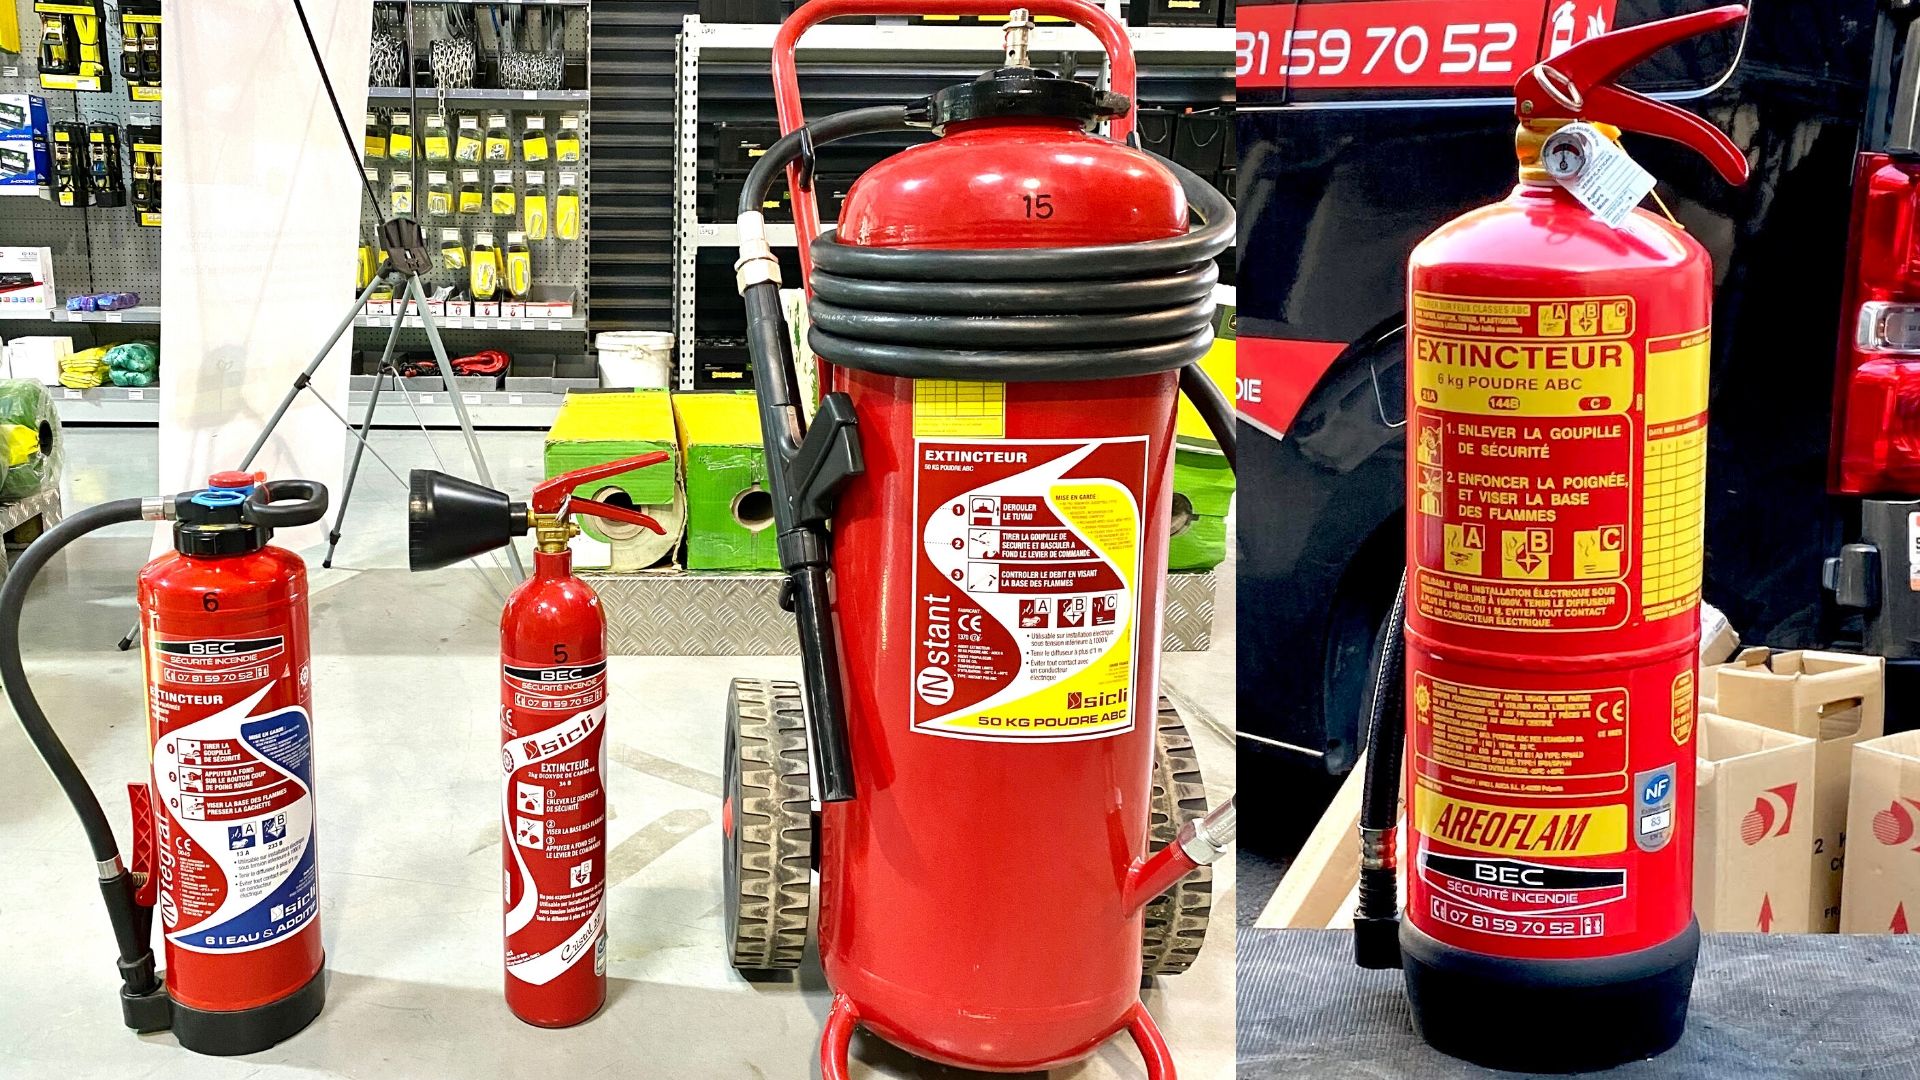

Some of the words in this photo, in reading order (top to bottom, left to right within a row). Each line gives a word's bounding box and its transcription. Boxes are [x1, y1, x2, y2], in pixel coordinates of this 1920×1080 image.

[1280, 29, 1351, 76] 59
[1361, 25, 1428, 74] 70
[1439, 22, 1518, 73] 52
[1022, 194, 1054, 221] 15
[1554, 304, 1566, 319] A
[1585, 303, 1598, 317] B
[1616, 302, 1626, 316] C
[1417, 338, 1623, 369] EXTINCTEUR
[1437, 373, 1444, 384] 6
[1447, 374, 1464, 389] kg
[1468, 376, 1538, 390] POUDRE
[1544, 378, 1583, 390] ABC
[1590, 399, 1600, 408] C
[1458, 424, 1516, 439] ENLEVER
[1523, 428, 1543, 439] LA
[1550, 425, 1622, 440] GOUPILLE
[925, 449, 1028, 463] EXTINCTEUR
[1458, 442, 1475, 454] DE
[1480, 441, 1550, 458] SÉCURITÉ
[1458, 472, 1530, 489] ENFONCER
[1537, 477, 1555, 489] LA
[1562, 472, 1629, 489] POIGNÉE,
[1458, 489, 1473, 501] ET
[1478, 490, 1518, 505] VISER
[1525, 493, 1543, 506] LA
[1551, 493, 1590, 506] BASE
[1002, 512, 1011, 520] LE
[1012, 512, 1033, 520] TUYAU
[1458, 505, 1482, 518] DES
[1489, 507, 1556, 521] FLAMMES
[1002, 533, 1019, 541] TIRER
[1020, 533, 1028, 541] LA
[1029, 533, 1058, 542] GOUPILLE
[1032, 541, 1040, 549] ET
[1040, 541, 1069, 550] BASCULER
[1465, 527, 1483, 548] A
[1531, 531, 1548, 551] B
[1602, 528, 1620, 550] C
[1001, 550, 1019, 559] FOND
[1020, 550, 1028, 558] LE
[1028, 550, 1049, 558] LEVIER
[1050, 550, 1058, 558] DE
[1058, 549, 1091, 558] COMMANDE
[1077, 568, 1098, 577] VISANT
[1001, 579, 1010, 587] LA
[1010, 579, 1029, 587] BASE
[1029, 579, 1042, 587] DES
[1043, 579, 1074, 587] FLAMMES
[1471, 584, 1530, 597] INSTALLATION
[1533, 585, 1590, 597] ÉLECTRIQUE
[1592, 586, 1616, 596] SOUS
[203, 592, 219, 613] 6
[1037, 601, 1048, 612] A
[1074, 599, 1084, 610] B
[1106, 596, 1116, 609] C
[1538, 608, 1562, 617] TOUT
[1564, 607, 1606, 617] CONTACT
[189, 642, 236, 655] BEC
[553, 643, 568, 664] 5
[170, 654, 213, 666] SÉCURITÉ
[214, 653, 259, 665] INCENDIE
[178, 674, 190, 682] 07
[192, 675, 204, 683] 81
[204, 675, 220, 684] 59
[222, 673, 237, 682] 70
[238, 671, 254, 680] 52
[540, 668, 583, 681] BEC
[521, 682, 563, 691] SÉCURITÉ
[563, 678, 597, 691] INCENDIE
[528, 699, 539, 707] 07
[553, 700, 568, 708] 59
[569, 698, 581, 707] 70
[1084, 688, 1127, 709] sicli
[979, 716, 1001, 726] 50
[1006, 717, 1029, 727] KG
[1034, 715, 1098, 727] POUDRE
[1101, 709, 1127, 722] ABC
[541, 714, 596, 755] sicli
[541, 758, 589, 773] EXTINCTEUR
[233, 798, 250, 806] BASE
[250, 795, 262, 804] DES
[262, 787, 288, 802] FLAMMES
[1645, 778, 1669, 801] NF
[276, 813, 286, 826] B
[1432, 802, 1592, 851] AREOFLAM
[245, 823, 255, 835] A
[1814, 838, 1824, 855] 2
[1475, 863, 1544, 886] BEC
[285, 883, 316, 917] sicli
[1447, 880, 1509, 901] SÉCURITÉ
[1511, 891, 1579, 905] INCENDIE
[1450, 909, 1468, 922] 07
[1472, 916, 1489, 928] 81
[1492, 919, 1517, 931] 59
[1521, 922, 1546, 934] 70
[1549, 923, 1575, 934] 52
[205, 936, 216, 946] 6
[226, 932, 260, 945] EAU
[262, 928, 274, 938] &
